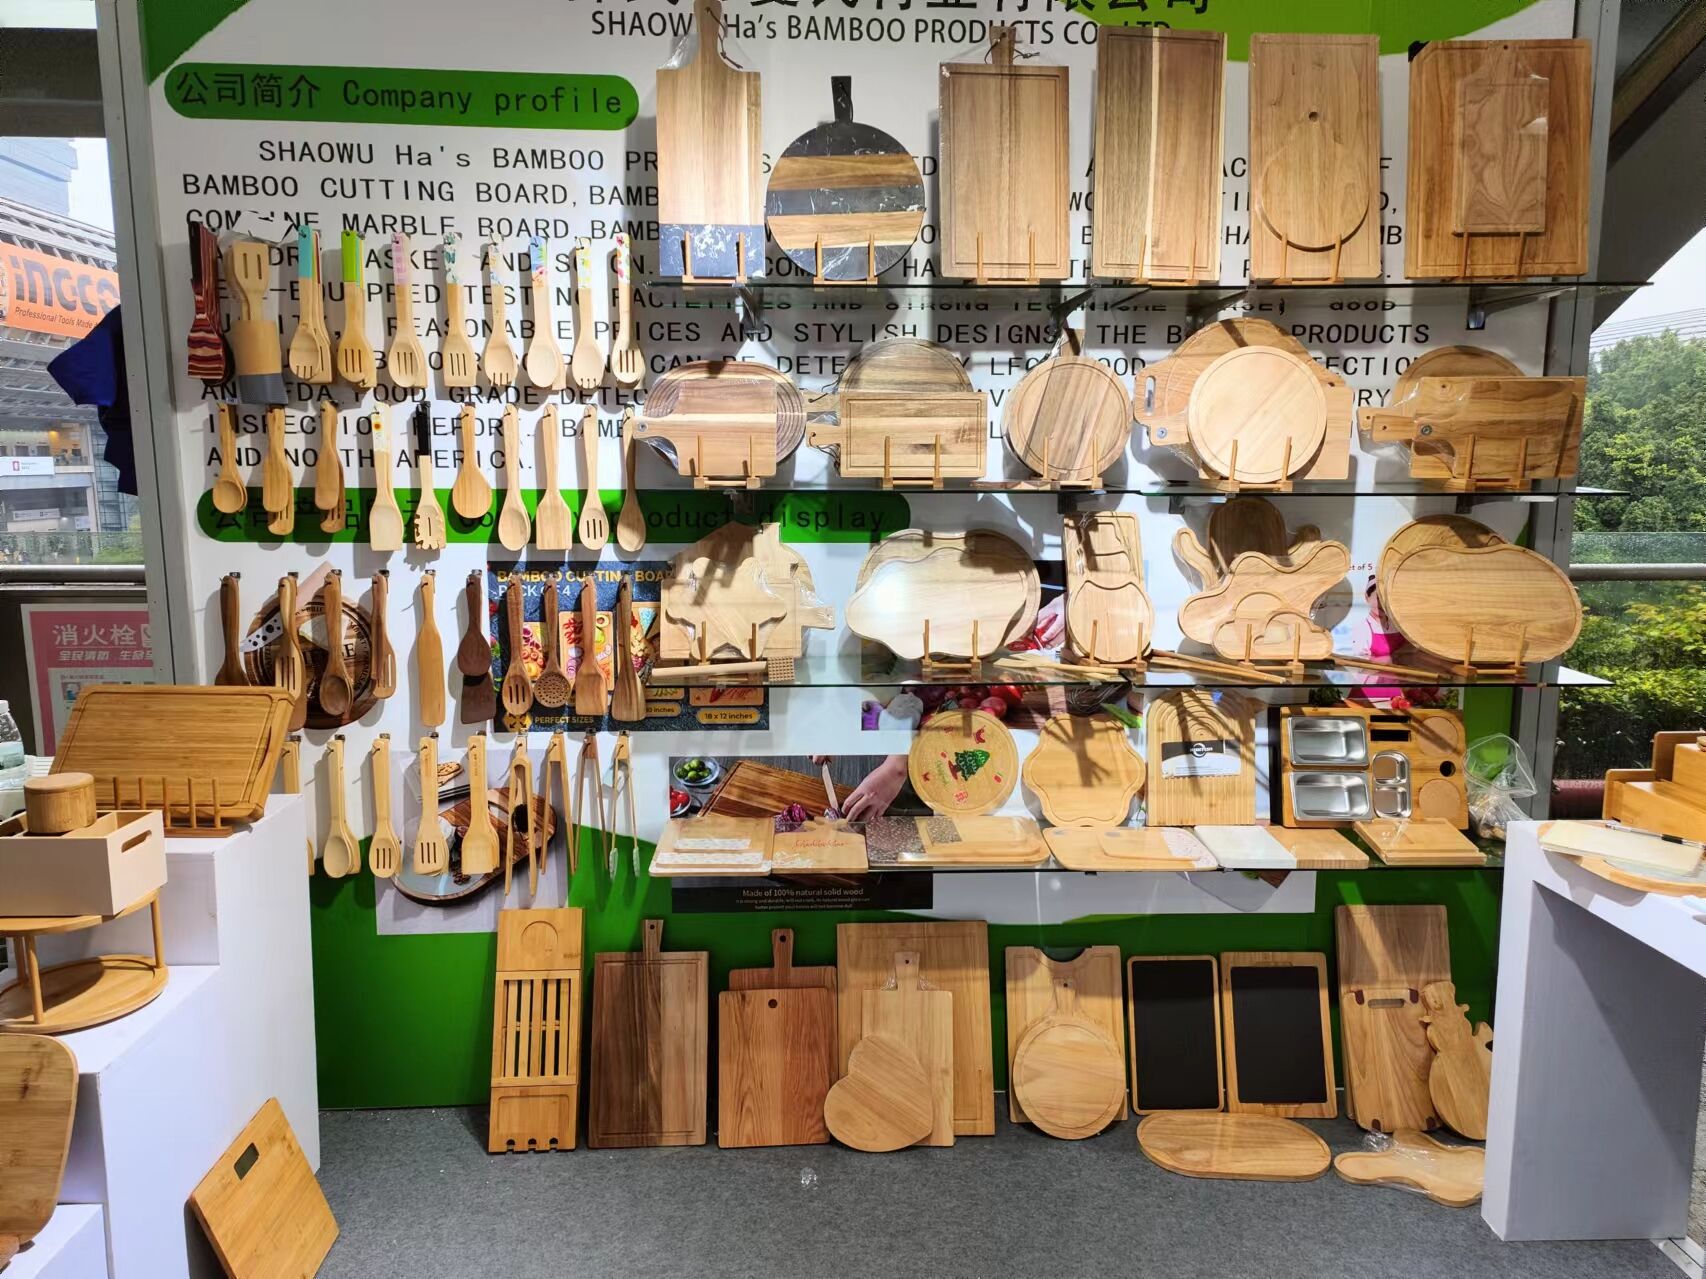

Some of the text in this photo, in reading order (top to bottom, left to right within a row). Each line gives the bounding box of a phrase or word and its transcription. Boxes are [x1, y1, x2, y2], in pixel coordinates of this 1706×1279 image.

[592, 10, 694, 38] SHAOW
[724, 14, 778, 40] Ha's
[787, 15, 906, 43] BAMBOO
[176, 71, 321, 109] 公司简介
[342, 79, 623, 117] Company profile
[258, 140, 375, 165] SHAOWU
[395, 144, 471, 168] Ha's
[492, 147, 605, 171] BAMBOO
[182, 173, 299, 197] BAMBOO
[320, 177, 455, 203] CUTTING
[476, 181, 577, 208] BOARD,
[794, 322, 917, 344] STYLISH
[1097, 325, 1146, 344] THE
[1291, 323, 1430, 344] PRODUCTS
[448, 385, 539, 405] GRADE
[562, 584, 571, 597] 4
[52, 623, 137, 646] 消火栓
[534, 715, 594, 724] PERFECT SIZES
[720, 712, 728, 720] 12
[728, 712, 753, 720] inches
[795, 888, 823, 896] natural
[823, 888, 842, 896] solid
[843, 888, 864, 896] wood
